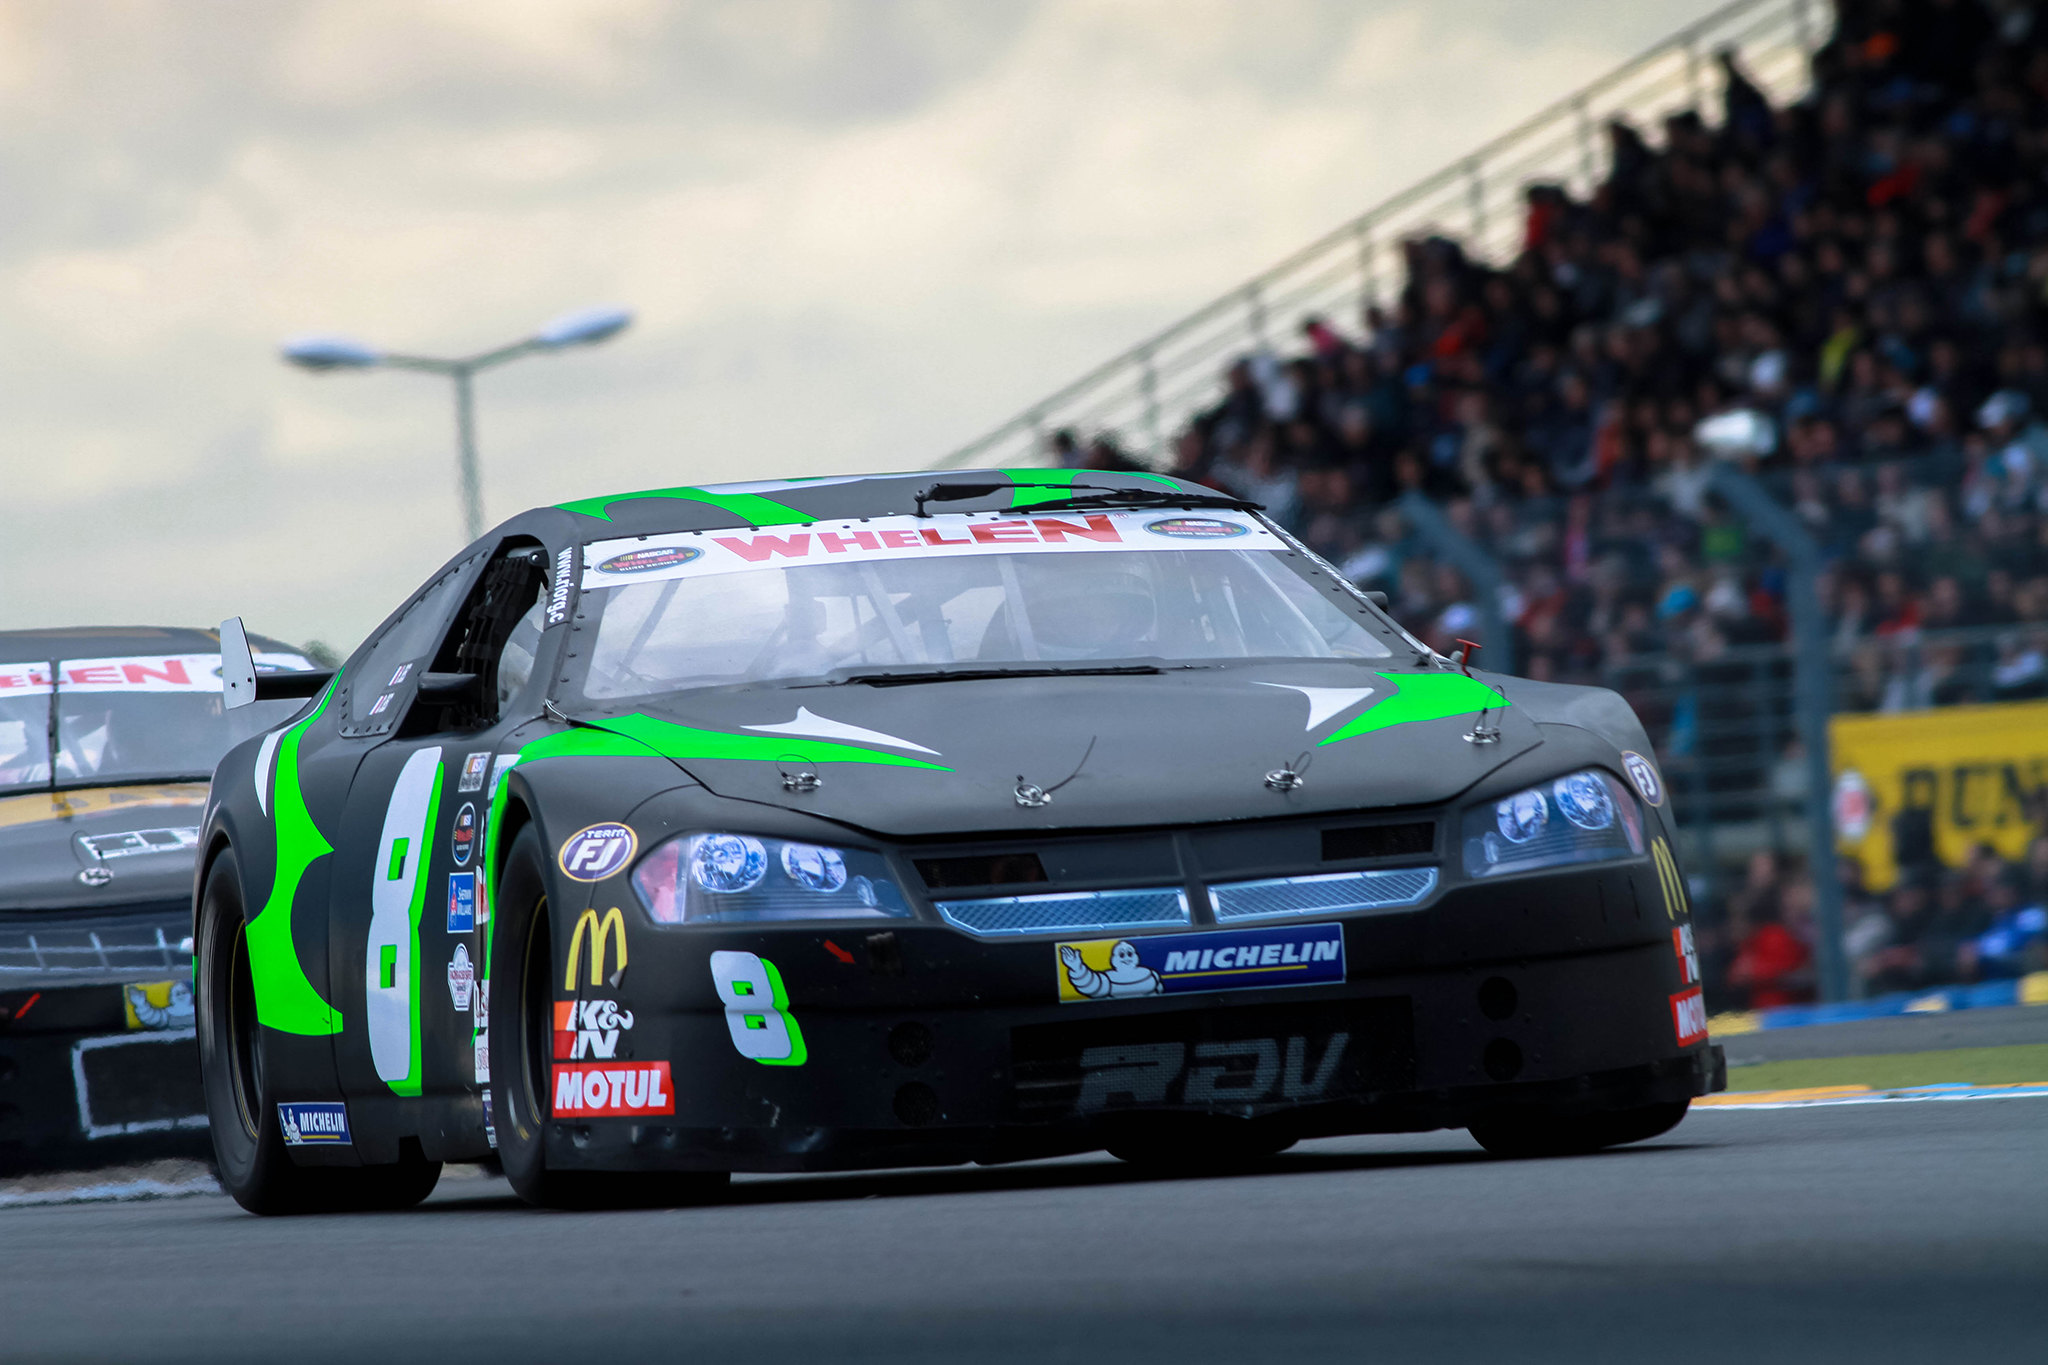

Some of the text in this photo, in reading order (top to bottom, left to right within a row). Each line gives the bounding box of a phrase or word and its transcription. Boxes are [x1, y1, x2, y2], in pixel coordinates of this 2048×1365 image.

[711, 514, 1122, 562] WHELEN
[586, 828, 626, 839] TEAM
[569, 838, 623, 871] FJ
[366, 745, 445, 1097] 8
[1164, 940, 1340, 972] MICHELIN
[710, 950, 808, 1066] 8
[555, 1070, 667, 1110] MOTUL
[300, 1111, 345, 1133] MICHELIN
